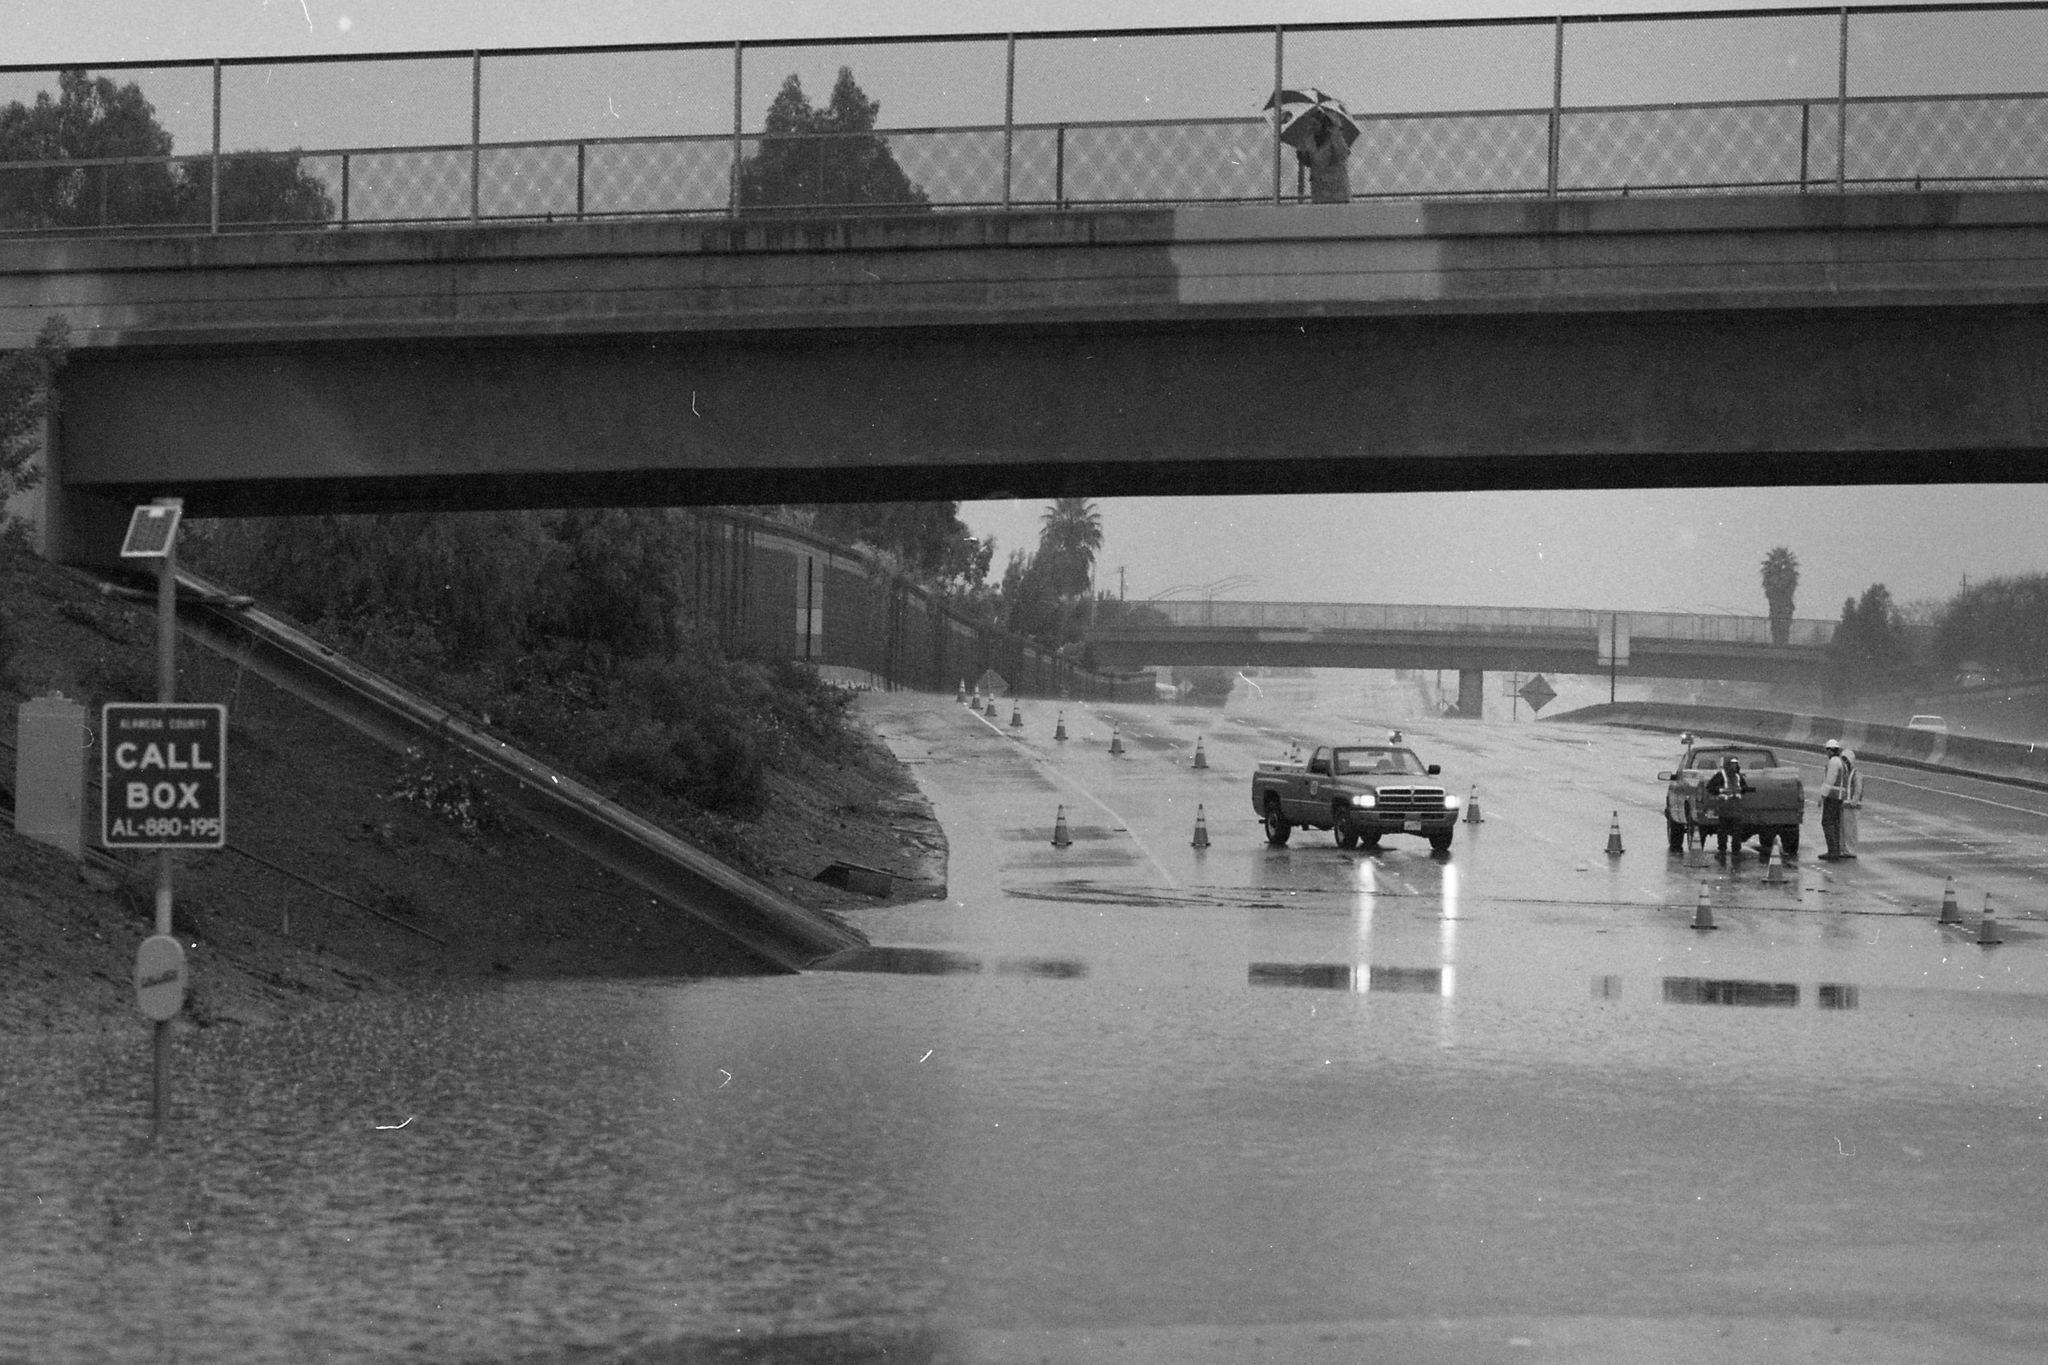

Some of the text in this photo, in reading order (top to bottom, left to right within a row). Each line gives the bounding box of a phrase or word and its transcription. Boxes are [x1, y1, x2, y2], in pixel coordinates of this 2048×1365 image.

[115, 742, 213, 770] CALL
[126, 782, 199, 809] BOX
[111, 818, 220, 837] AL-880-195
